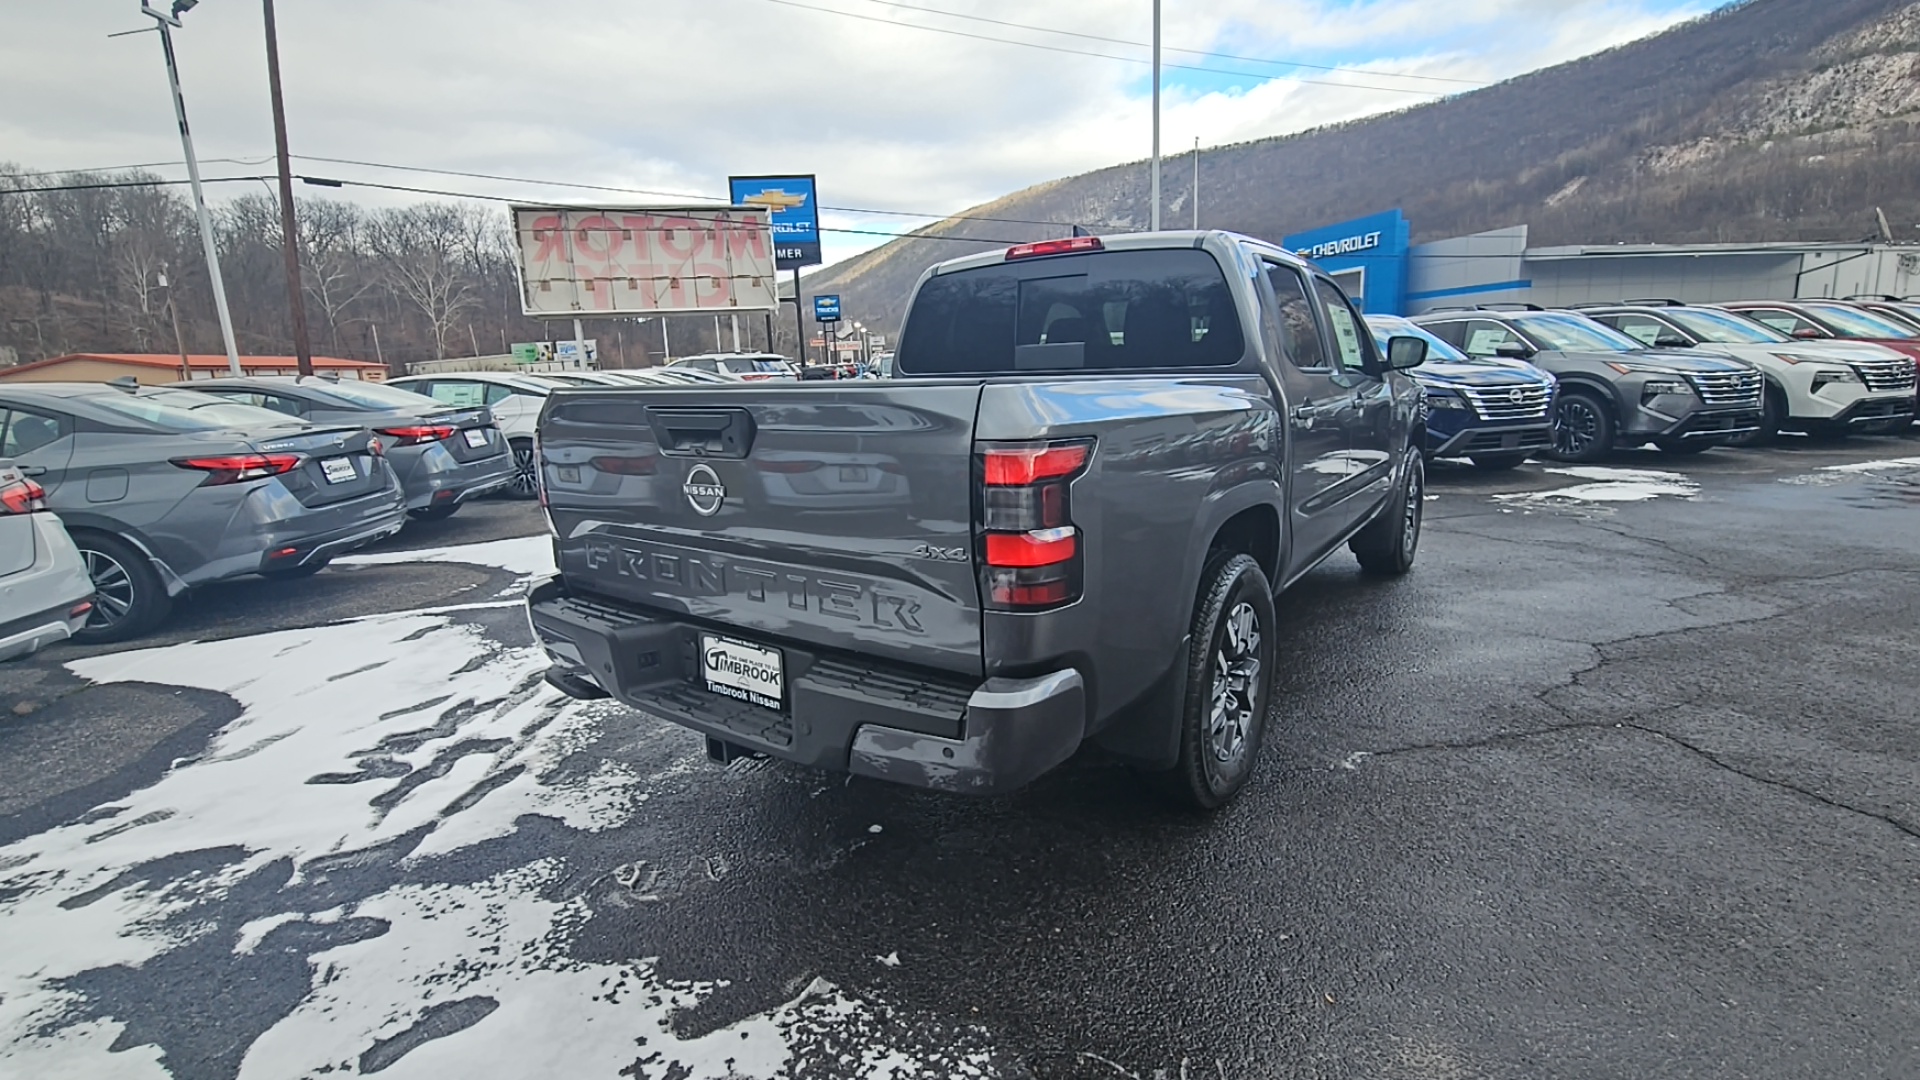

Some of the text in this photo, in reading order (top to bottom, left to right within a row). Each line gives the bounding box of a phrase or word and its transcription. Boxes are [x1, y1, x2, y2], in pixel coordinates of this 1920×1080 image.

[773, 221, 811, 233] ROLET
[776, 248, 802, 259] MER
[1312, 231, 1381, 259] CHEVROLET
[683, 484, 725, 497] NISSAN
[584, 539, 926, 633] FRONTIER
[705, 647, 780, 686] TIMBROOK
[749, 660, 764, 668] PLACE
[706, 681, 781, 710] Timbrook Nissan
